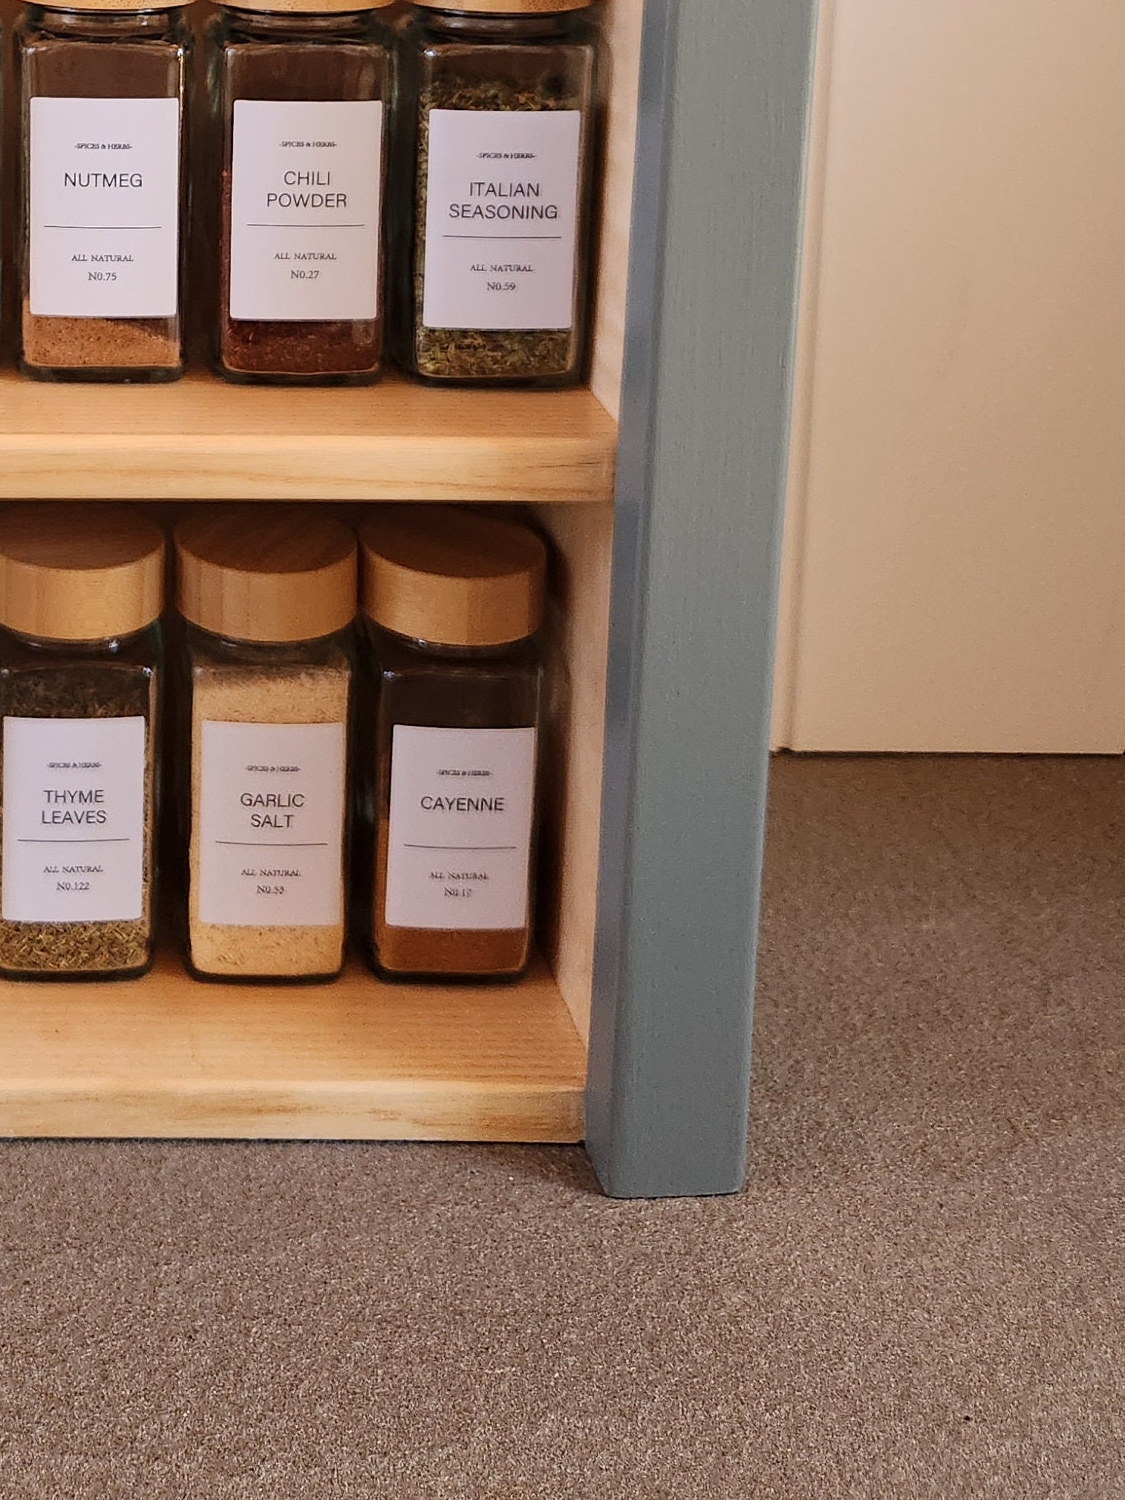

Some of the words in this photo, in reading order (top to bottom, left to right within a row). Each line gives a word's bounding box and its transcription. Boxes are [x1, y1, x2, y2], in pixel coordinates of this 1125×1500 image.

[63, 172, 143, 188] NUTMEG
[283, 170, 331, 187] CHILI
[469, 181, 542, 198] ITALIAN
[266, 192, 347, 209] POWDER
[448, 203, 561, 220] SEASONING
[71, 253, 88, 263] ALL
[91, 253, 135, 263] NATURAL
[274, 252, 291, 261] ALL
[294, 252, 338, 261] NATURAL
[470, 263, 487, 273] ALL
[490, 263, 535, 273] NATURAL
[43, 789, 104, 805] THYME
[240, 792, 306, 810] GARLIC
[420, 795, 506, 813] CAYENNE
[41, 809, 108, 826] LEAVES
[250, 813, 296, 829] SALT
[43, 866, 59, 876] ALL
[62, 866, 104, 876] NATURAL
[241, 868, 256, 879] ALL
[260, 868, 302, 879] NATURAL
[429, 871, 445, 883] ALL
